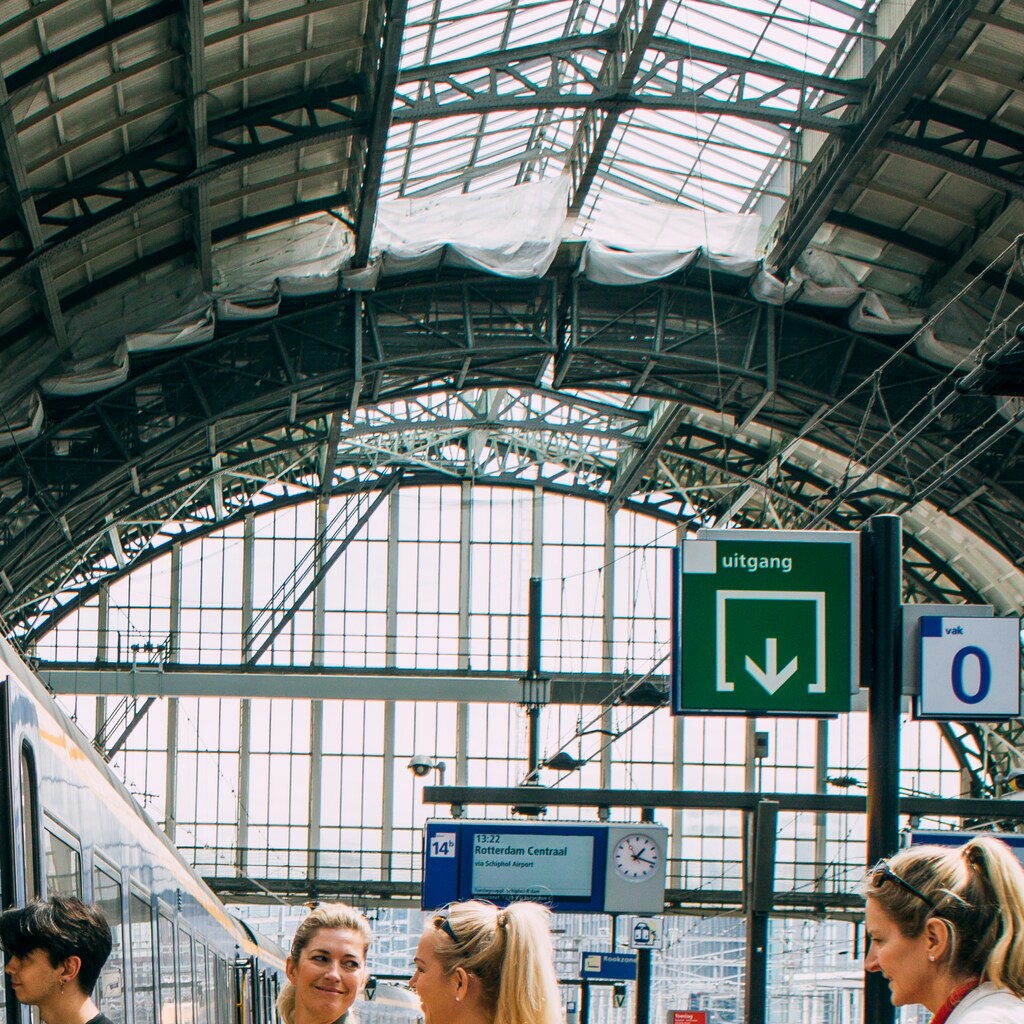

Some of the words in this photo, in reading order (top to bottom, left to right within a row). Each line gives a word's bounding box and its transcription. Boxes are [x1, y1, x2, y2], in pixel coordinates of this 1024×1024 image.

[722, 552, 793, 573] uitgang
[945, 626, 964, 636] vak
[476, 835, 501, 843] 13:22
[474, 846, 525, 856] Rotterdam
[527, 846, 568, 857] Centraal
[485, 860, 511, 868] Schiphol
[512, 861, 534, 869] Airport
